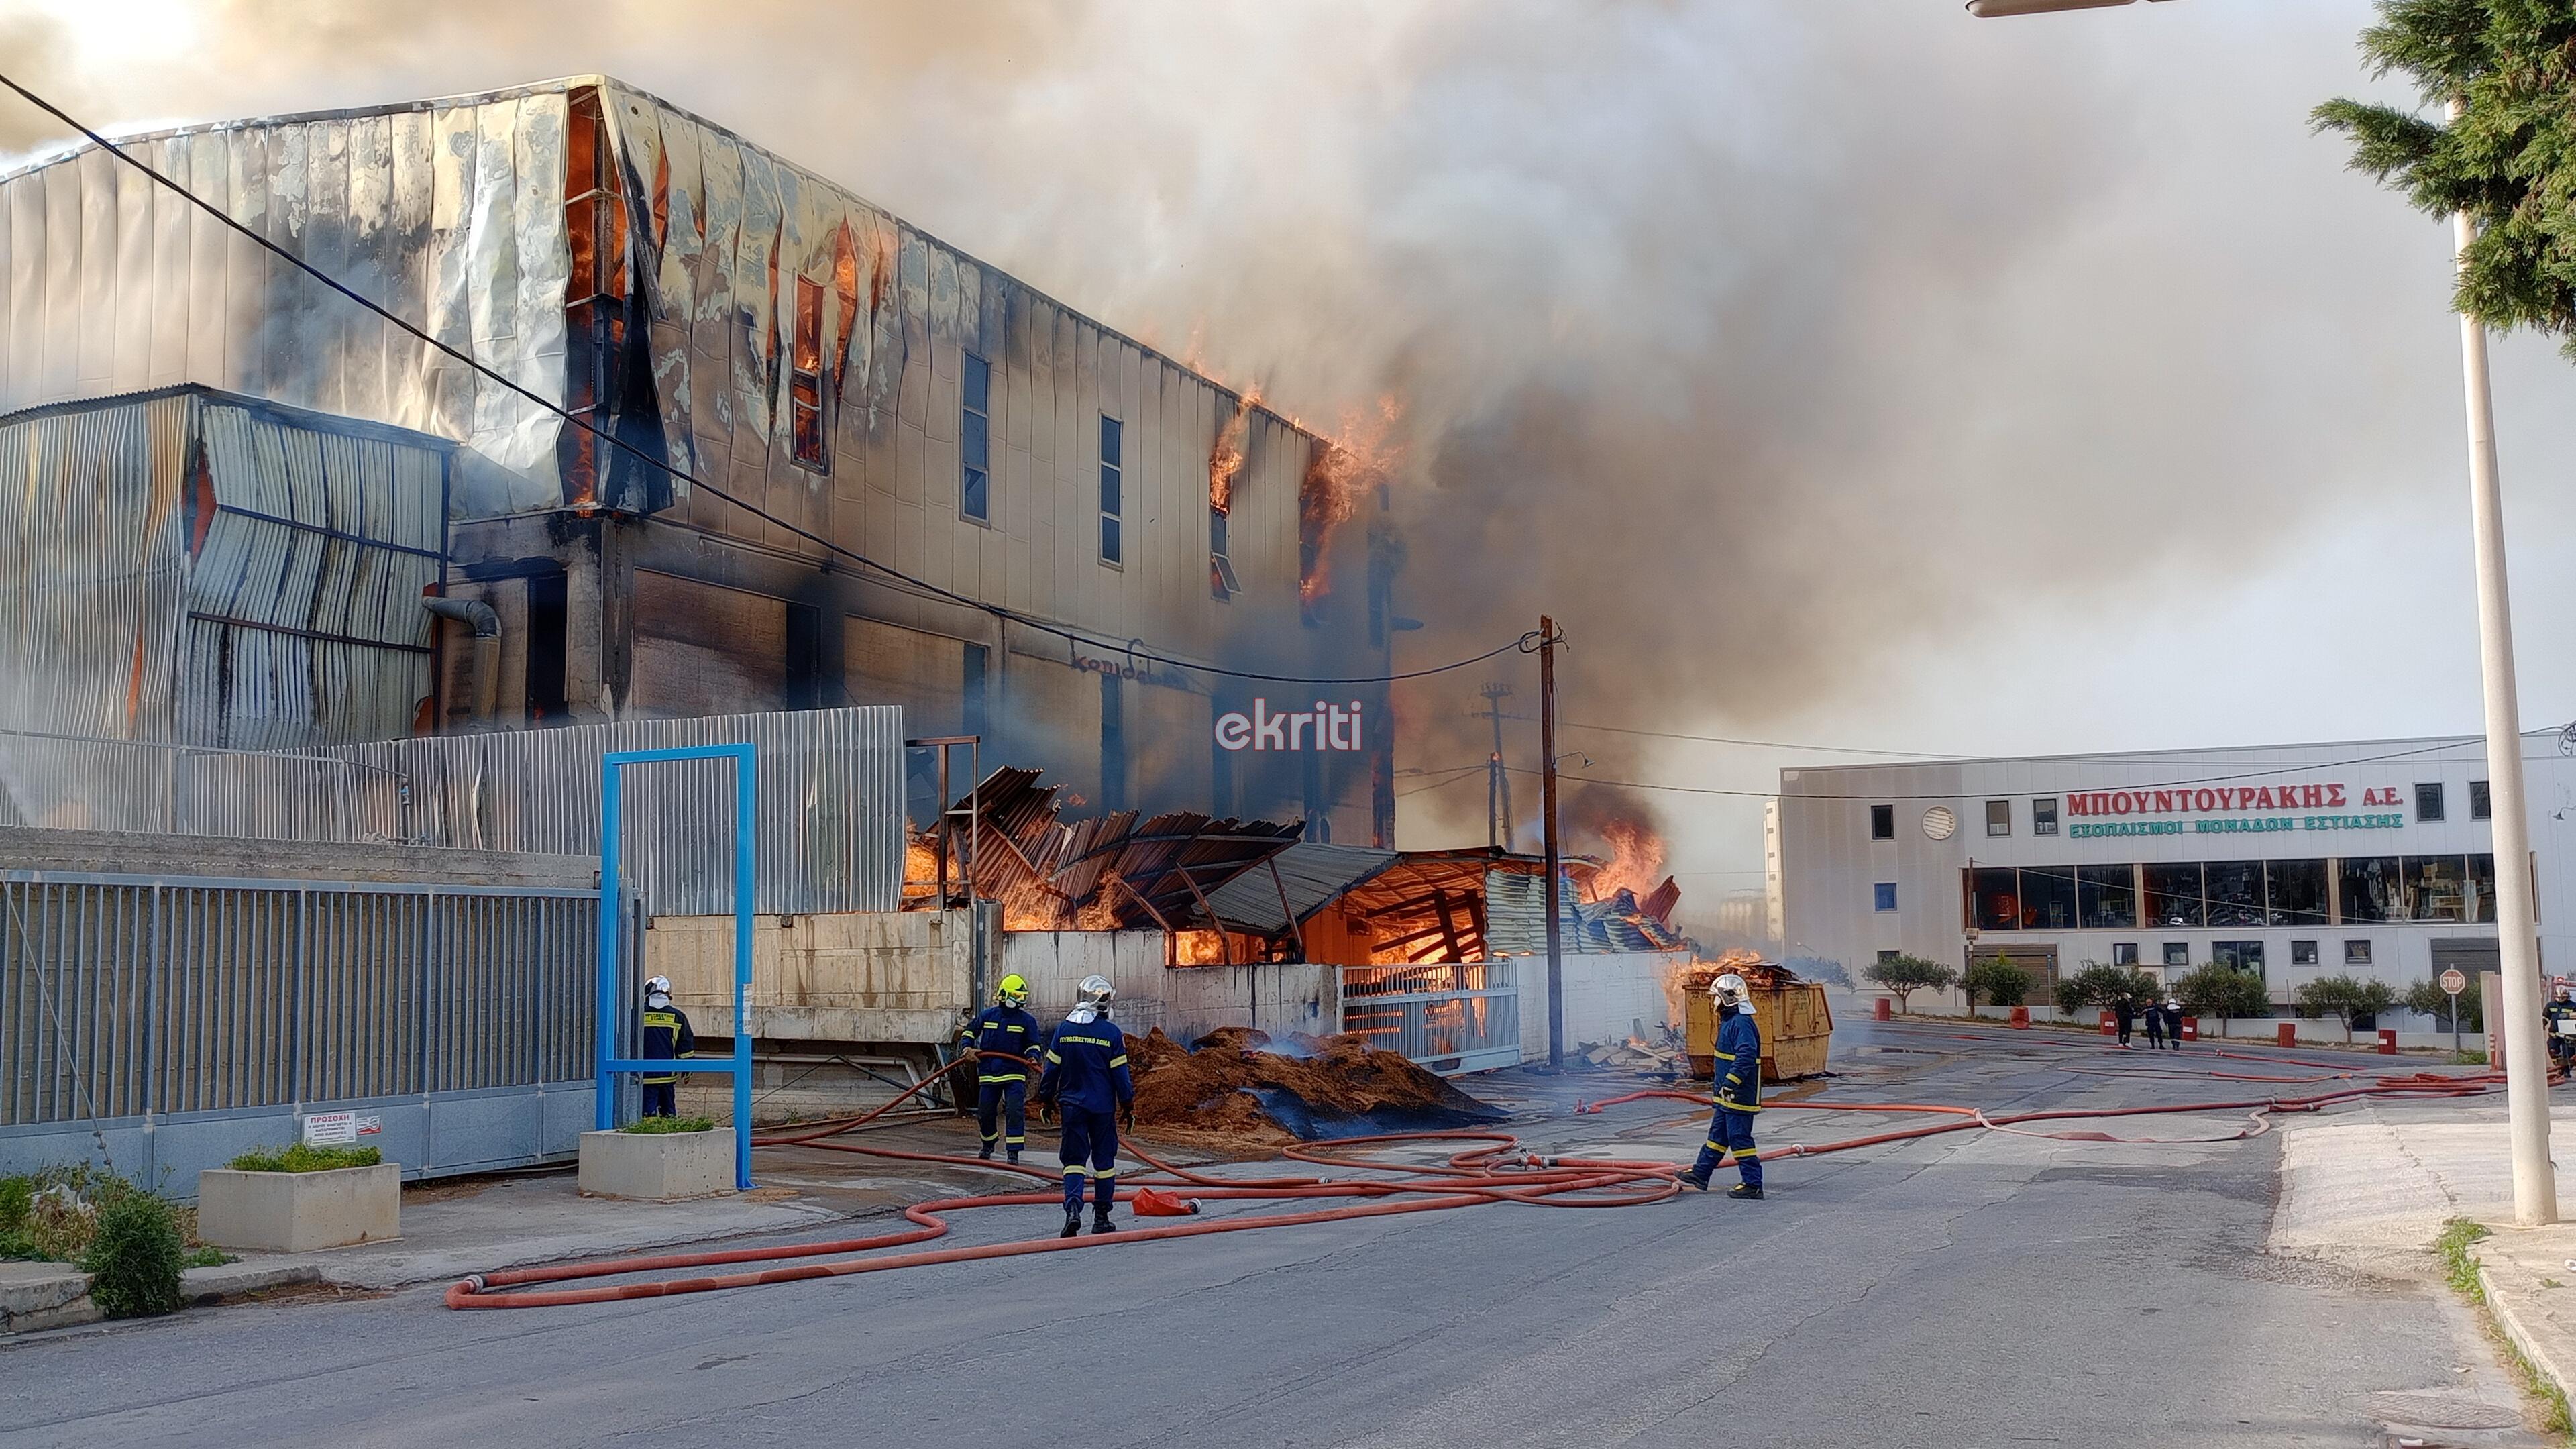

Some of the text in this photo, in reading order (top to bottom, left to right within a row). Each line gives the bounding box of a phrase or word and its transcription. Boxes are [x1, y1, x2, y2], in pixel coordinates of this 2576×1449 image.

[2067, 784, 2404, 816] ΜΠΟΥΝΤΟΥΡΑΚΗΣ Α.Ε.
[2070, 814, 2403, 839] ΕΞΟΠΛΙΣΜΟΙ ΜΟΝΑΔΩΝ ΕΣΤΙΑΣΗΣ
[2443, 976, 2463, 988] STOP
[311, 1114, 349, 1123] ΠΡΟΣΟΧΗ
